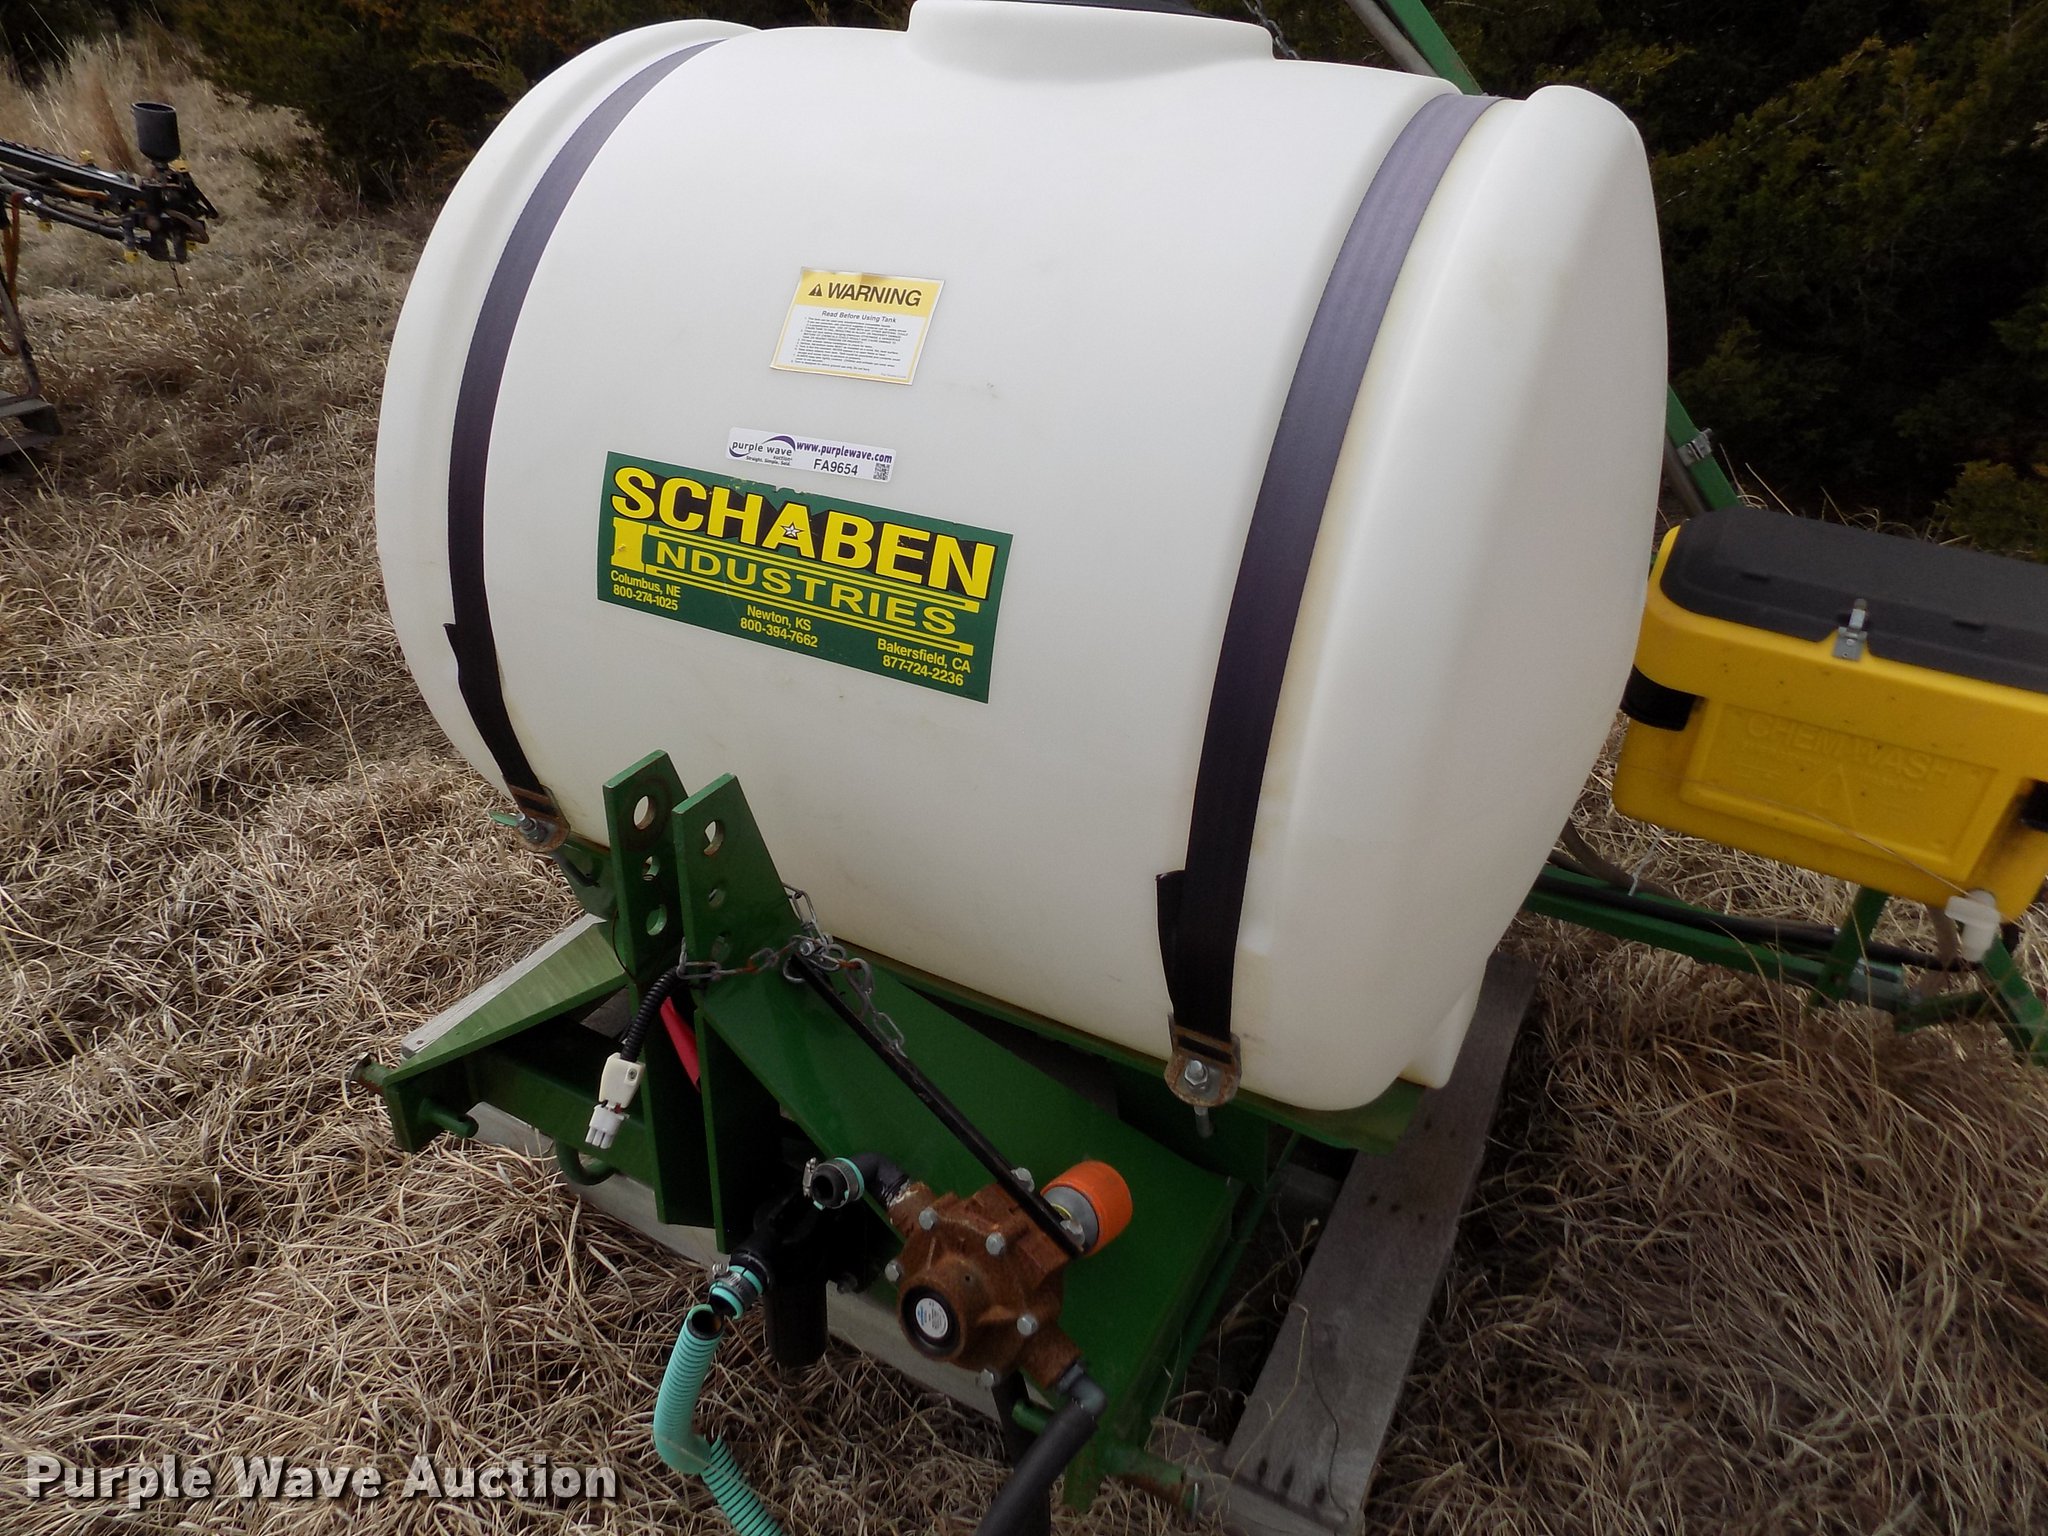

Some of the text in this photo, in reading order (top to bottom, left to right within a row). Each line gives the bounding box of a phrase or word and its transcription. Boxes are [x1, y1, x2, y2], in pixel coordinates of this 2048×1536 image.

[828, 282, 922, 307] WARNING
[822, 310, 896, 323] Read Before Using Tank
[732, 441, 793, 456] purple wave
[796, 441, 893, 464] www.purplewave.com
[813, 458, 859, 476] FA9654
[611, 467, 996, 600] SCHABEN
[611, 517, 956, 635] INDUSTRIES
[611, 570, 681, 598] Columbus, NE
[613, 584, 678, 611] 800-274-1025
[747, 604, 812, 631] Newton, KS
[740, 617, 818, 648] 800-394-7662
[877, 638, 971, 673] Bakersfield, CA
[882, 655, 964, 686] 877-724-2236
